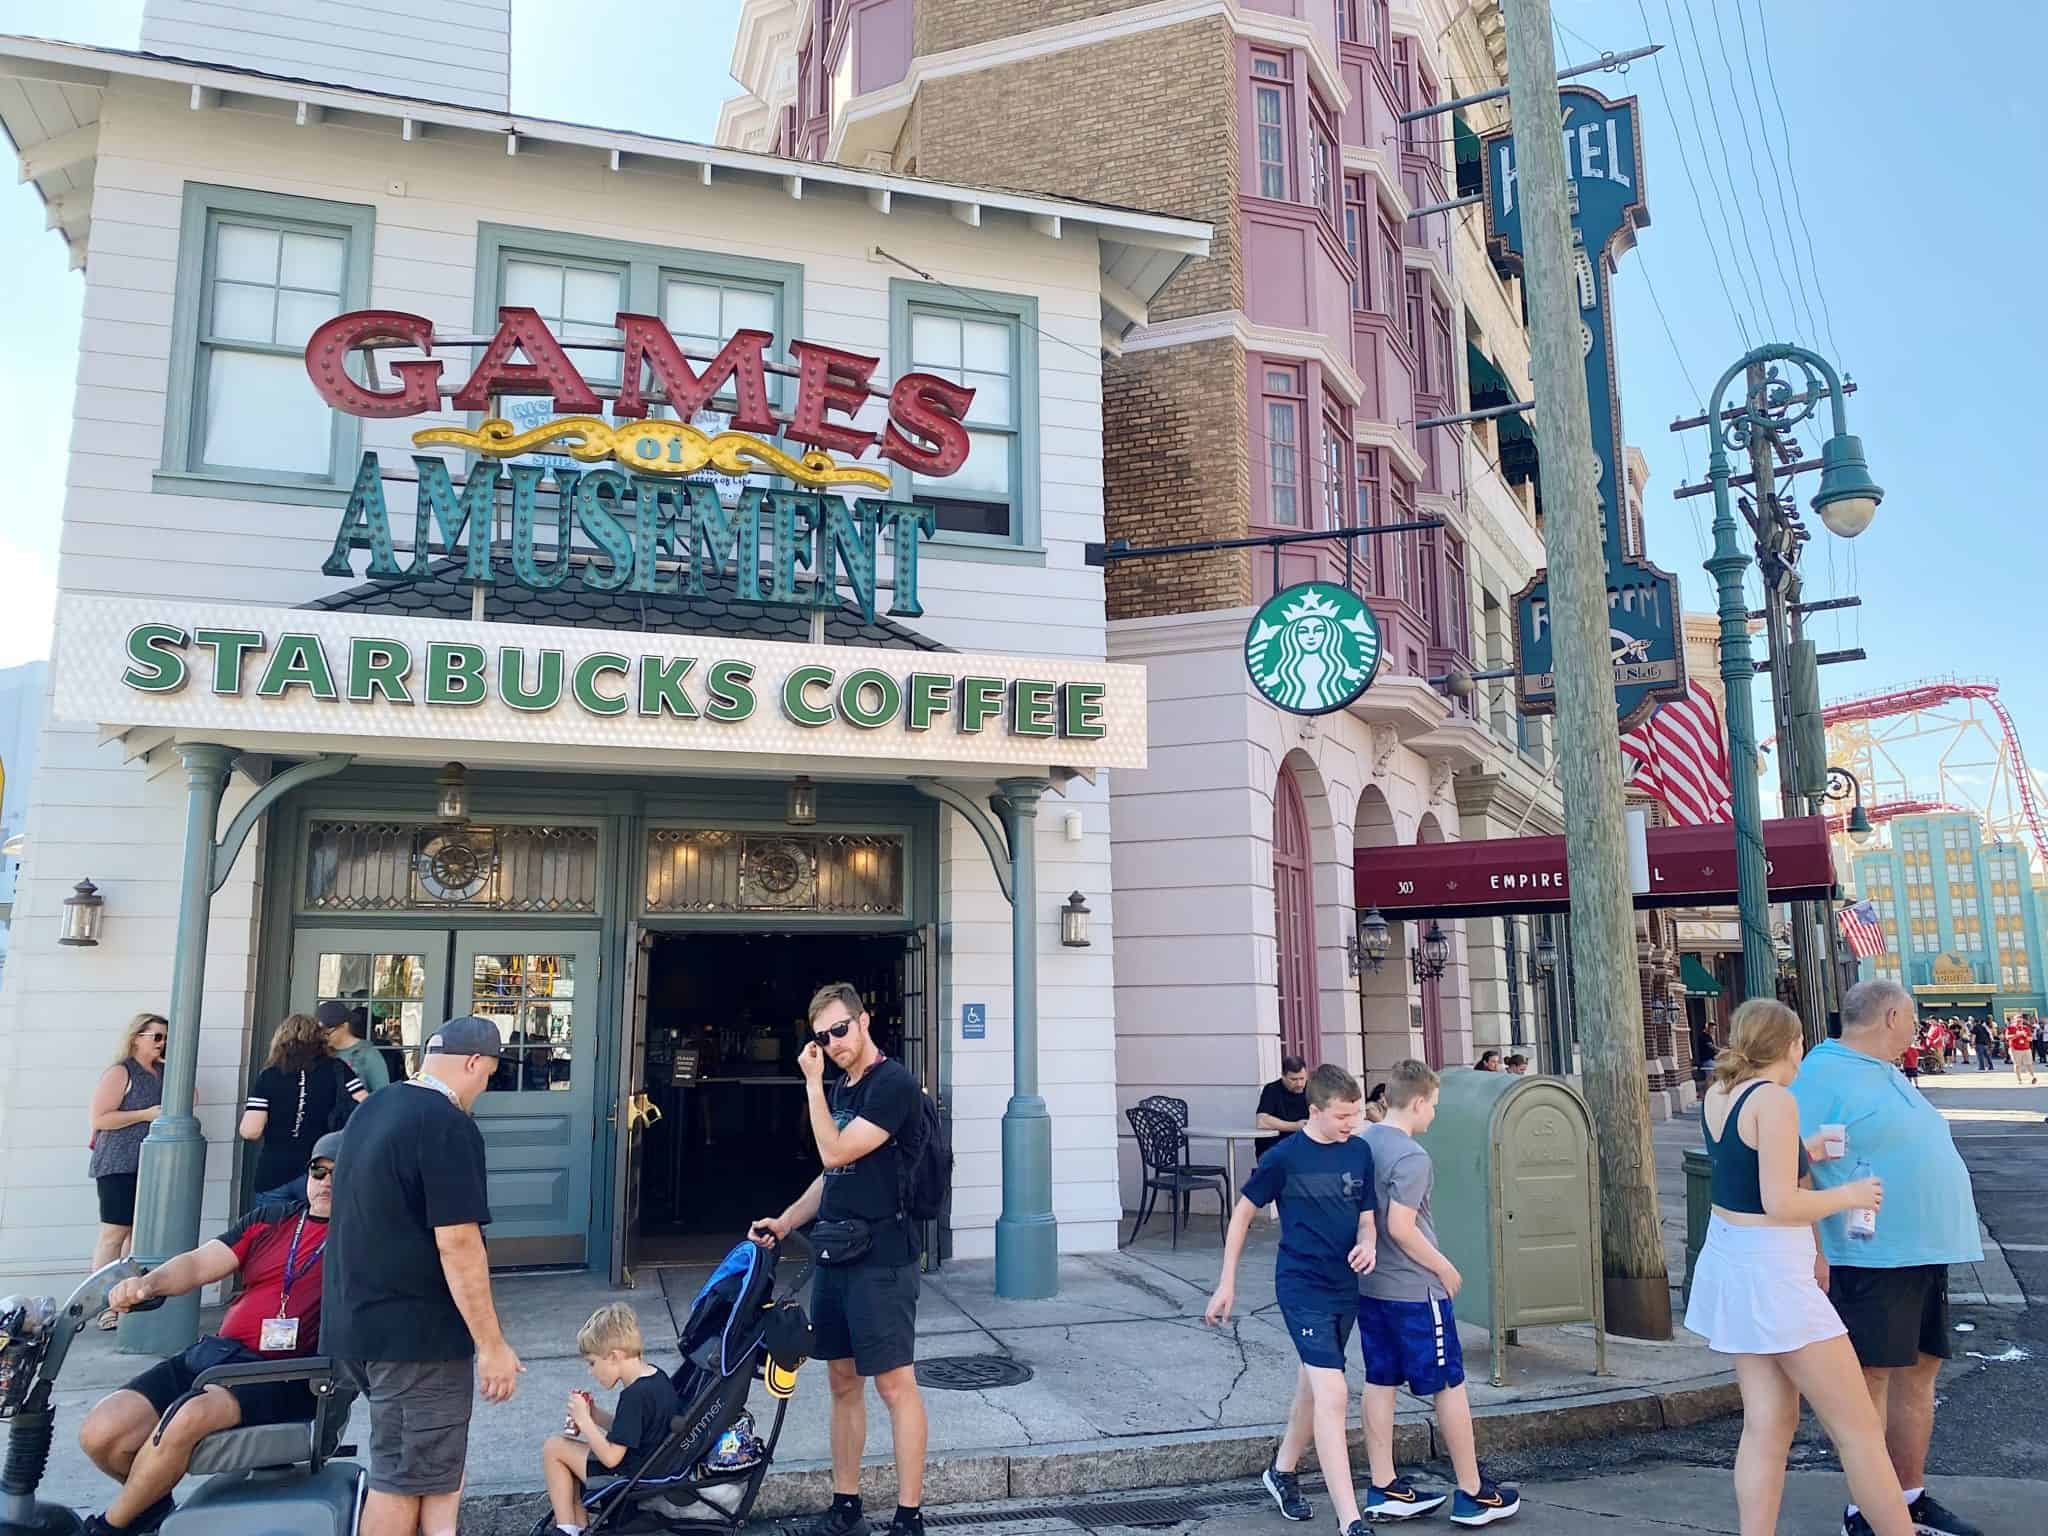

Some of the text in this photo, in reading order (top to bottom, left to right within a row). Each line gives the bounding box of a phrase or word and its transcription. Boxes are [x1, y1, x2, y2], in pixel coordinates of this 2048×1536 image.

[1499, 119, 1631, 216] HTEL
[305, 306, 976, 477] GAMES
[322, 451, 936, 624] AMUSEMENT
[121, 622, 1107, 739] STARBUCKS COFFEE
[1490, 872, 1563, 889] EMPIRE
